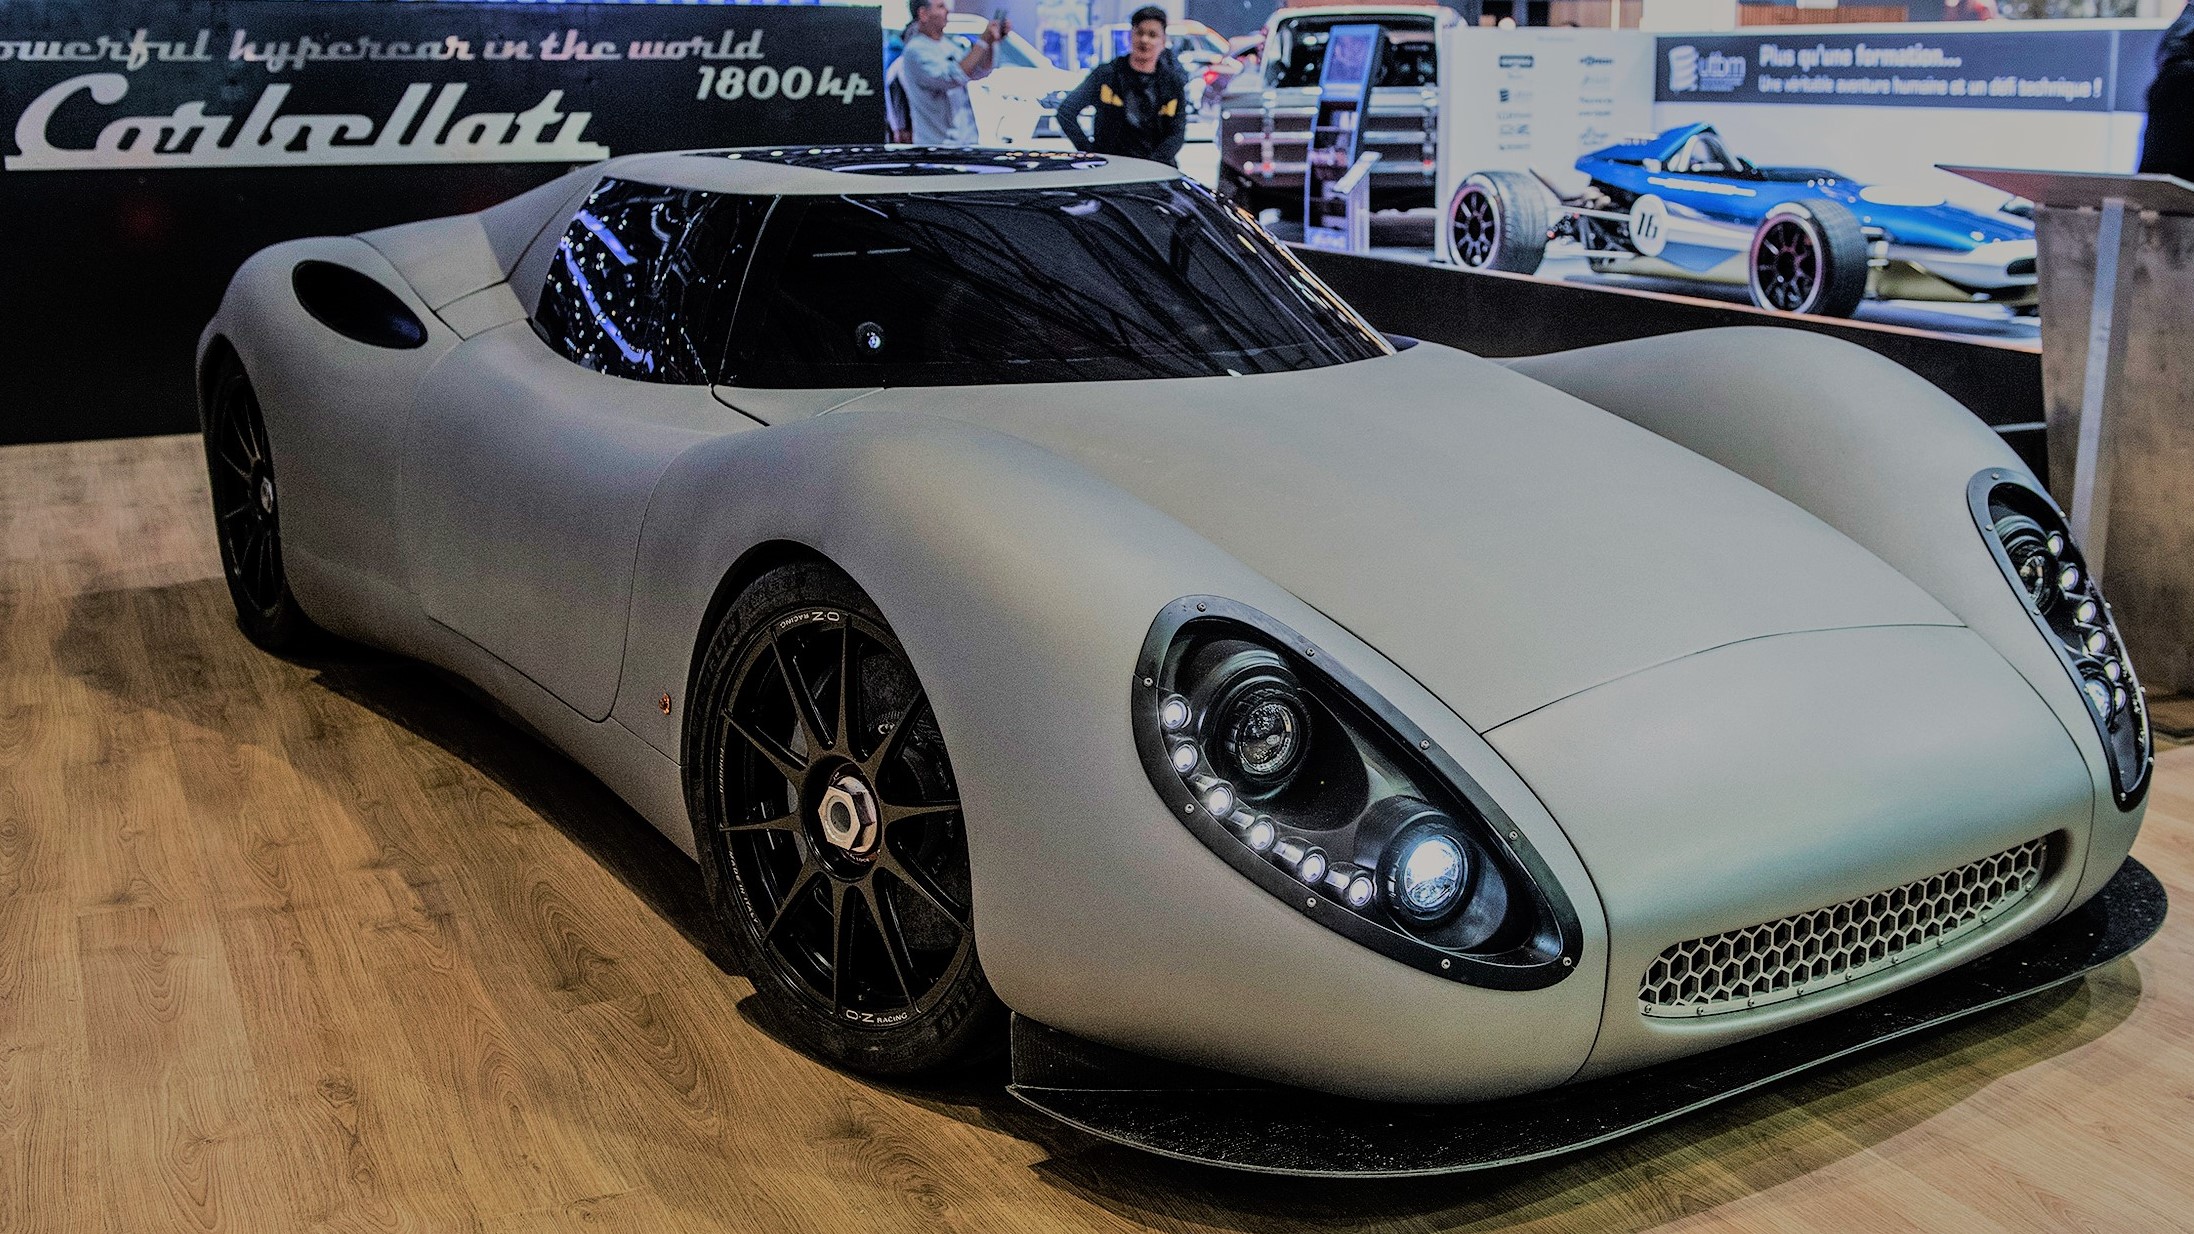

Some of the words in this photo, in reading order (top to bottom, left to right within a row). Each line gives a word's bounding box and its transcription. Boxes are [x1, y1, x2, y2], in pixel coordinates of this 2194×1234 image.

[228, 29, 474, 73] hypercar
[483, 35, 532, 60] in
[540, 29, 621, 61] the
[628, 29, 765, 60] world
[1759, 44, 1796, 67] Plus
[697, 65, 813, 99] 1800
[816, 65, 874, 104] hp
[5, 72, 610, 172] Corbellati
[1637, 213, 1658, 238] 16
[779, 613, 810, 629] RACING
[876, 1012, 908, 1024] RACING
